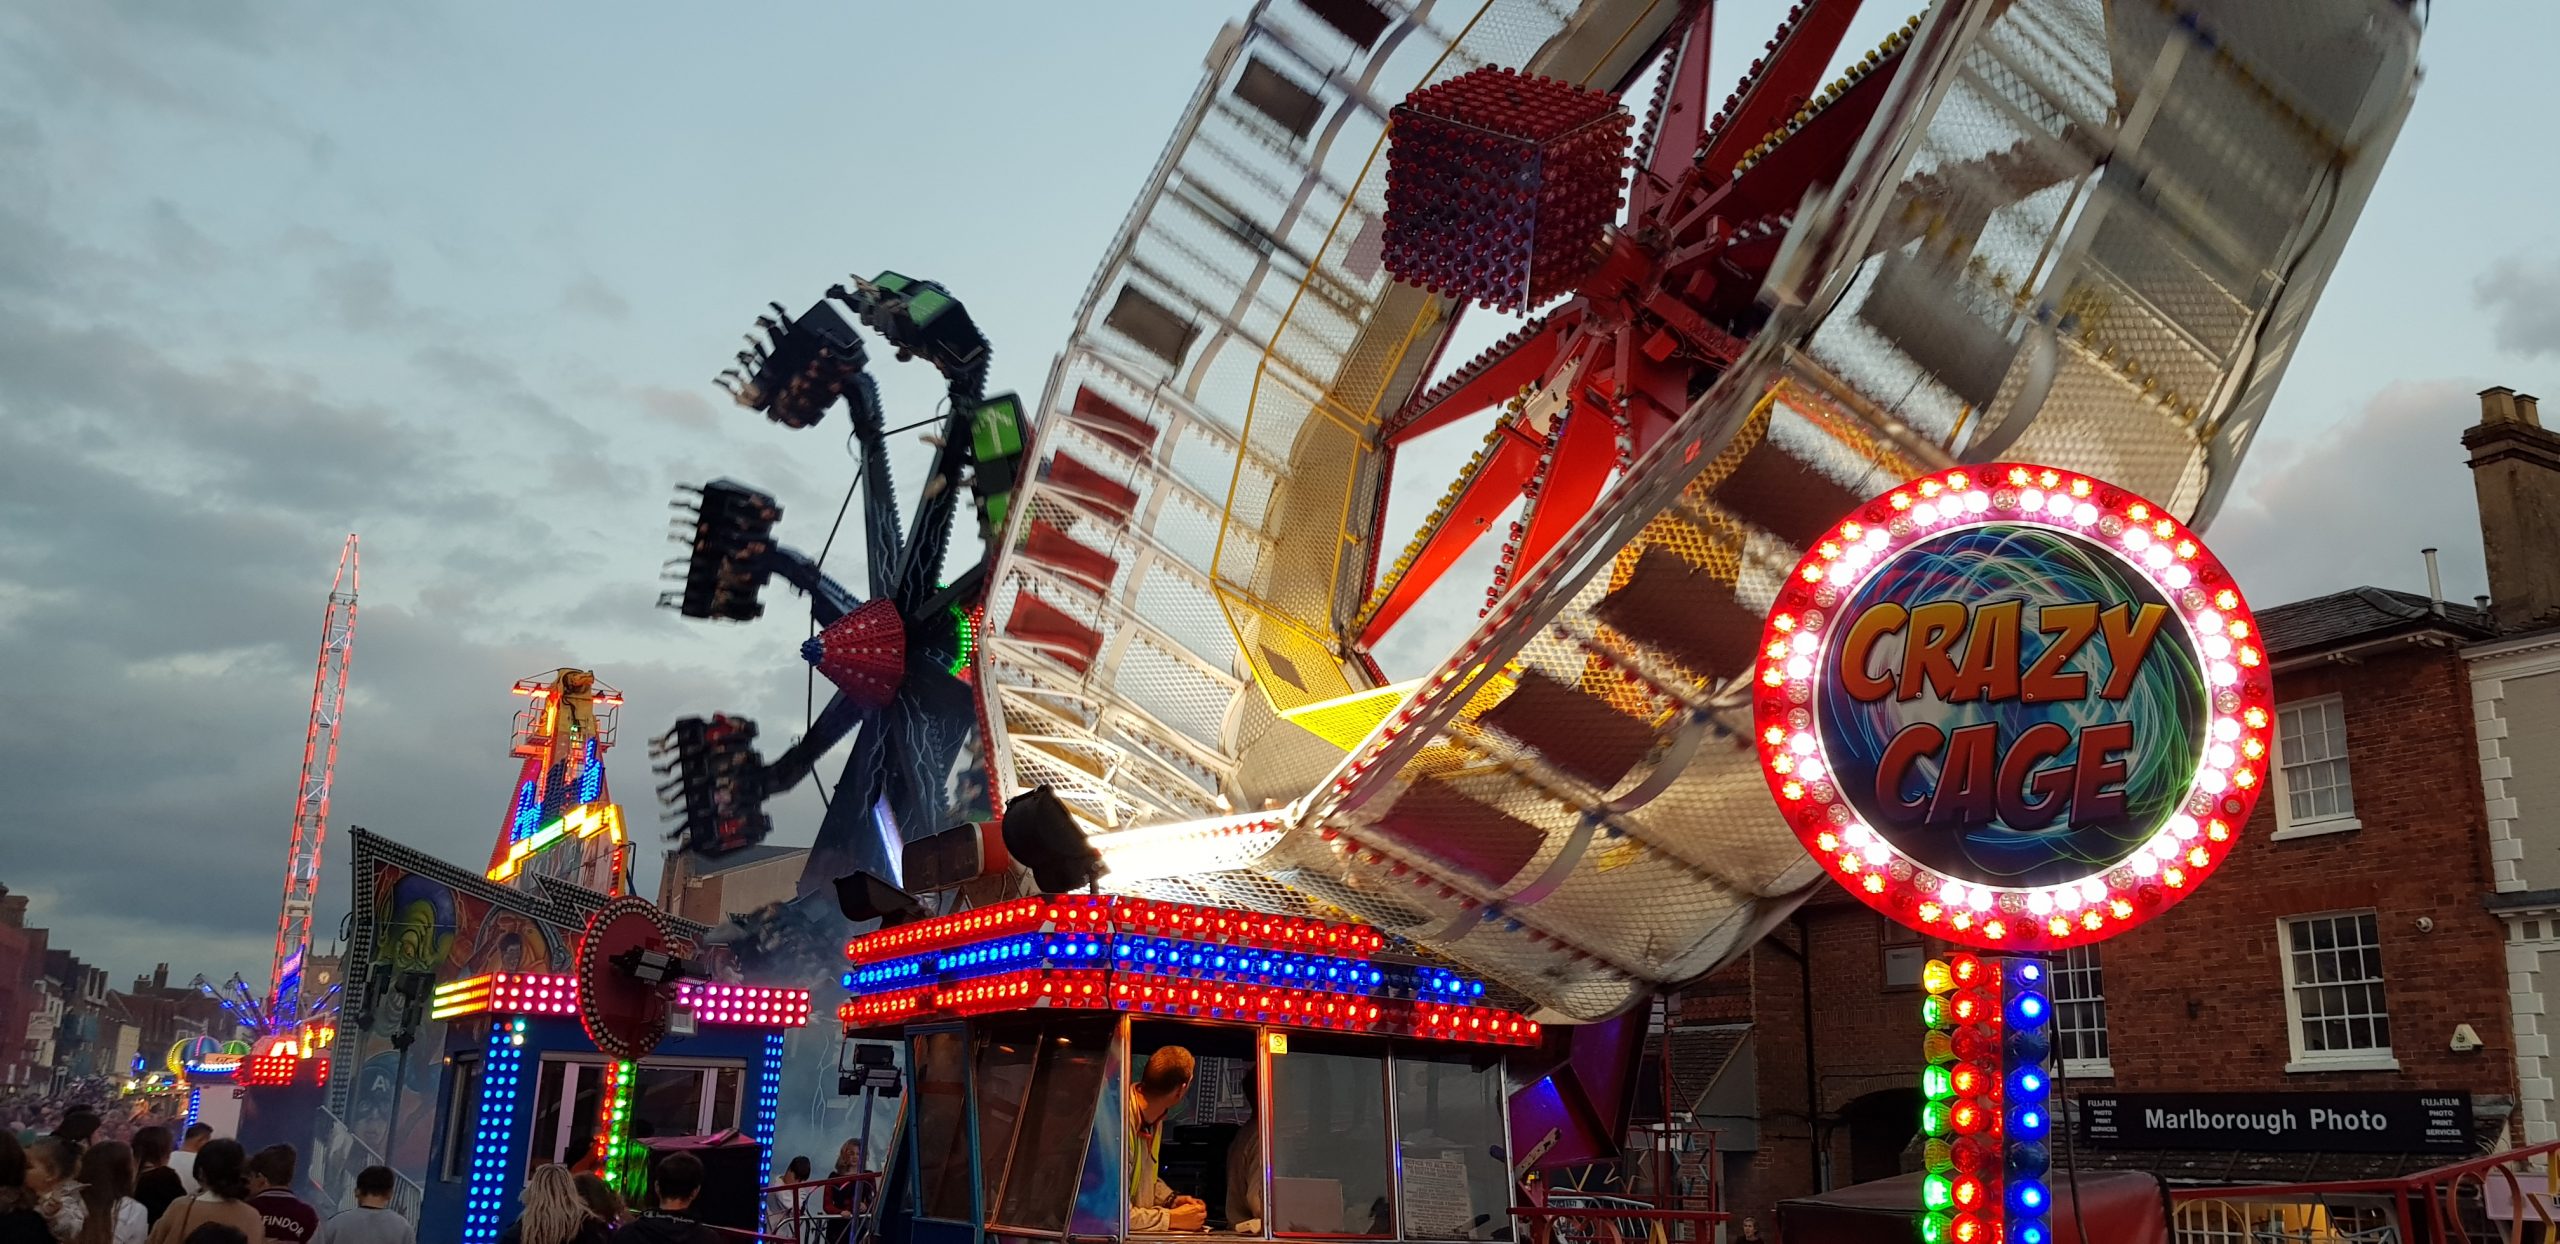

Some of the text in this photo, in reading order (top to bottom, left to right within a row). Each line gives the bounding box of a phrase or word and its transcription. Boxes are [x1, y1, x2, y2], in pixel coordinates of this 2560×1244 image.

[1839, 599, 2170, 704] CRAZY
[1874, 721, 2133, 832] CAGE
[2145, 1108, 2387, 1134] Marlborough Photo
[260, 1215, 304, 1238] FINDOR
